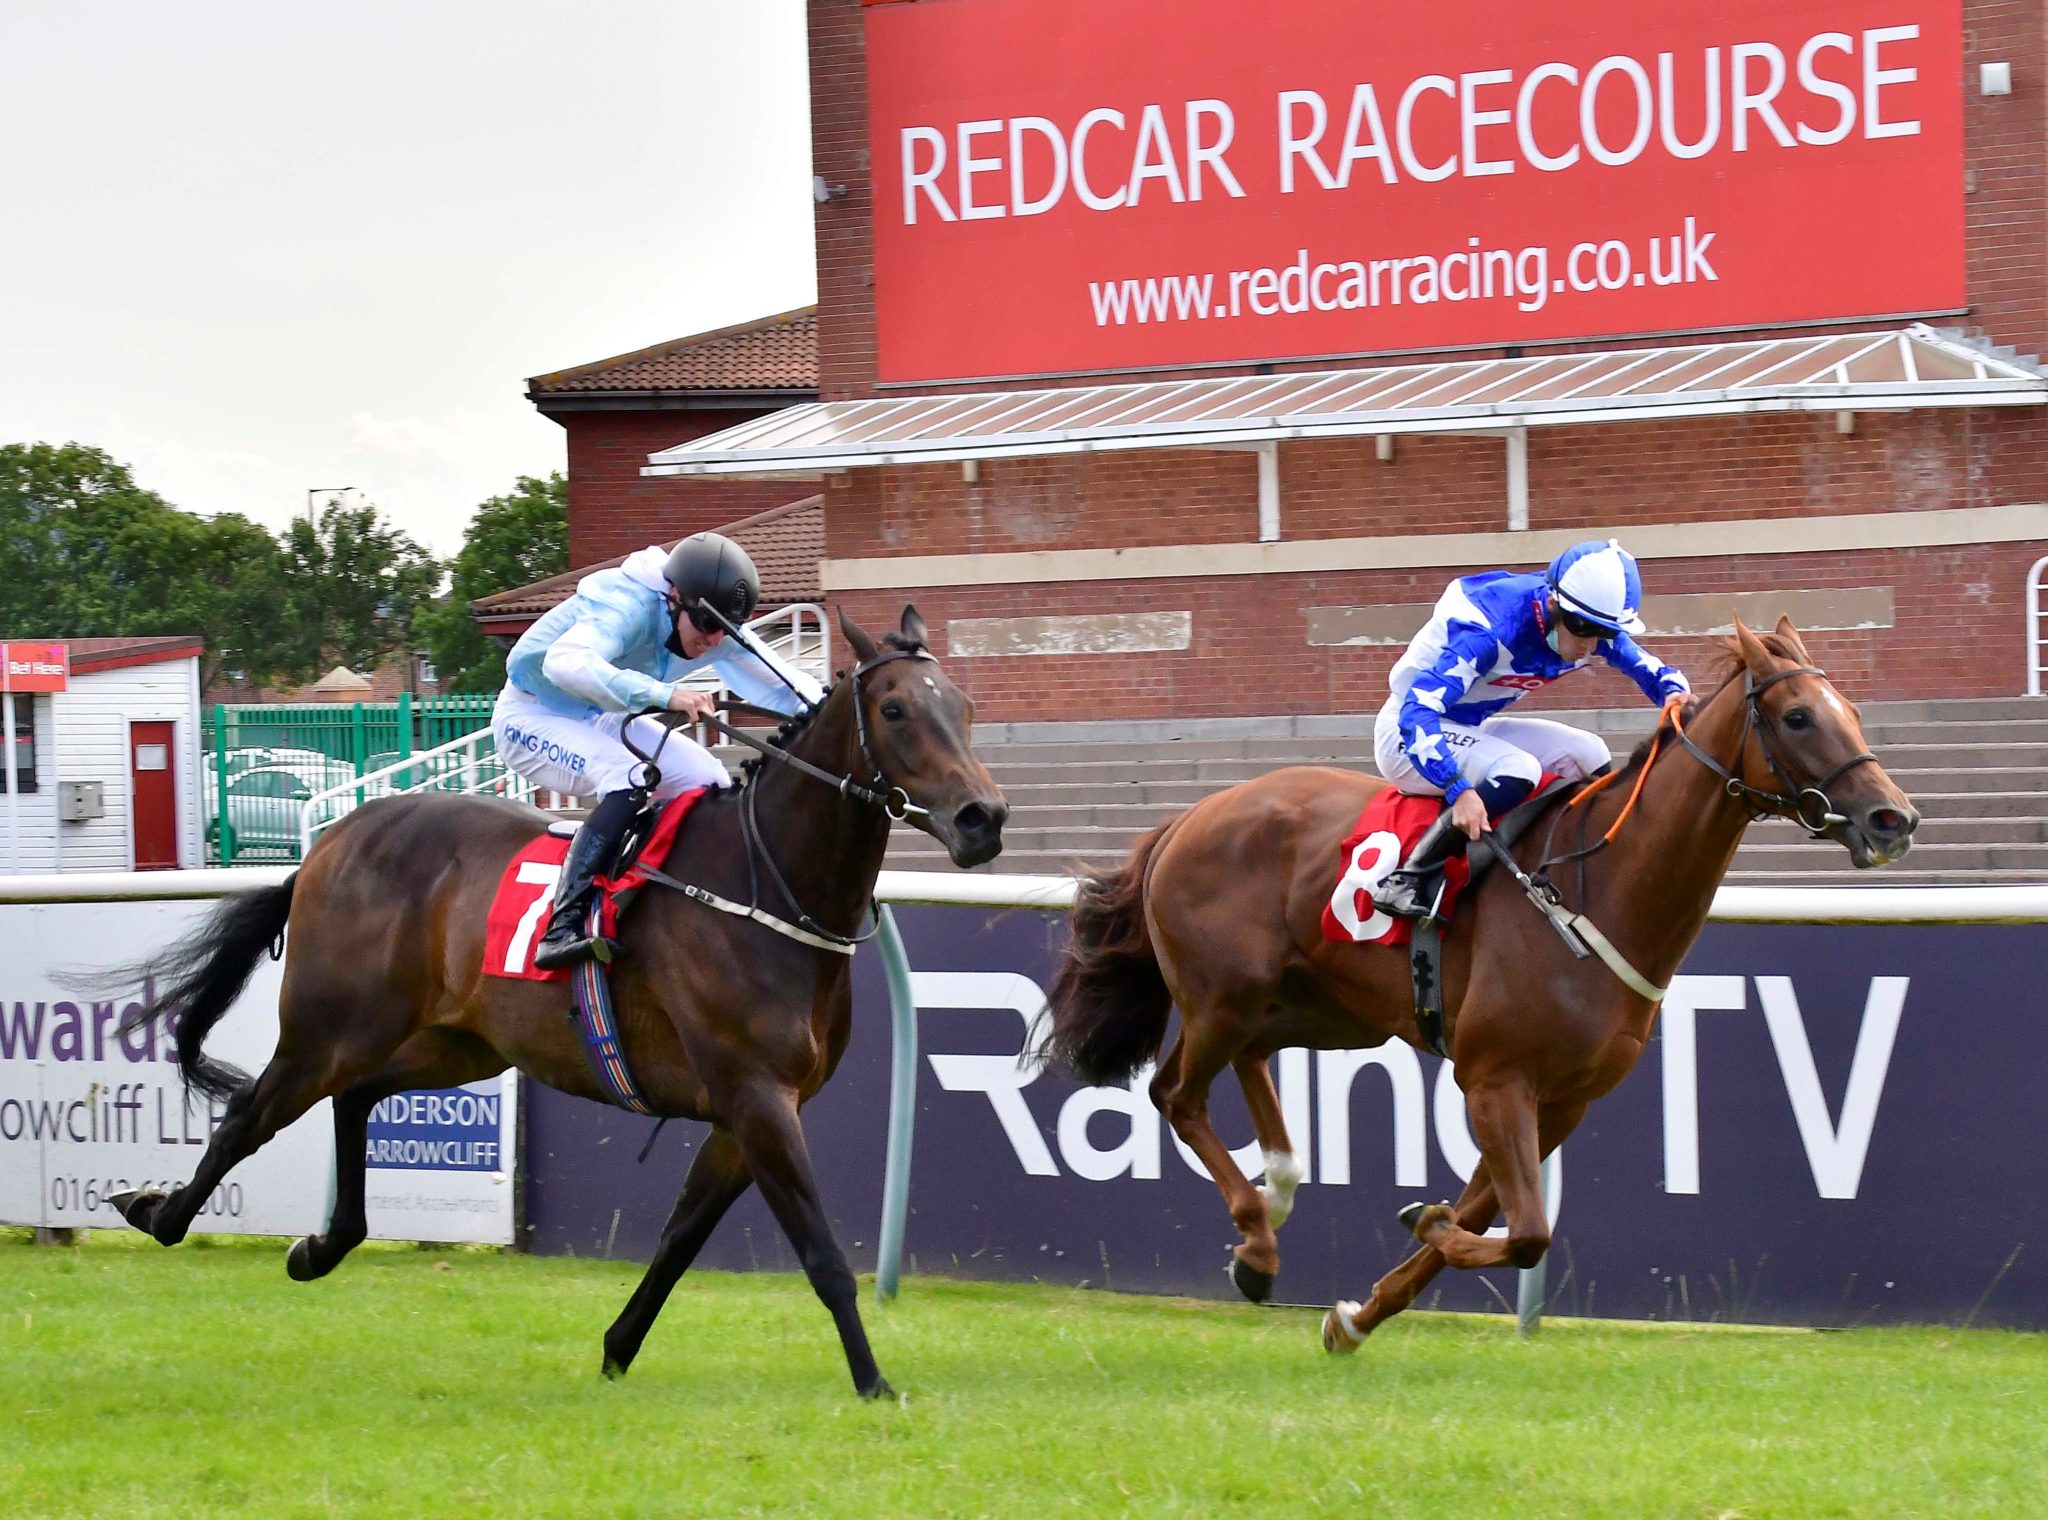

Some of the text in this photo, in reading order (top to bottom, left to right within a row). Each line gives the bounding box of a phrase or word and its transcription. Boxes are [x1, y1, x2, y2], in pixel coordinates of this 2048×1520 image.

[901, 24, 1921, 227] REDCAR RACECOURSE
[1089, 217, 1720, 327] www.redcarracing.co.uk
[9, 661, 64, 676] Bet Here
[504, 724, 586, 775] KING POWER
[504, 862, 561, 973] 7
[1331, 831, 1401, 941] 8
[0, 976, 184, 1063] wards
[0, 1083, 146, 1143] owcliff
[368, 1094, 498, 1126] NDERSON
[1662, 974, 1911, 1202] TV
[366, 1138, 498, 1166] ARROWCLIFF
